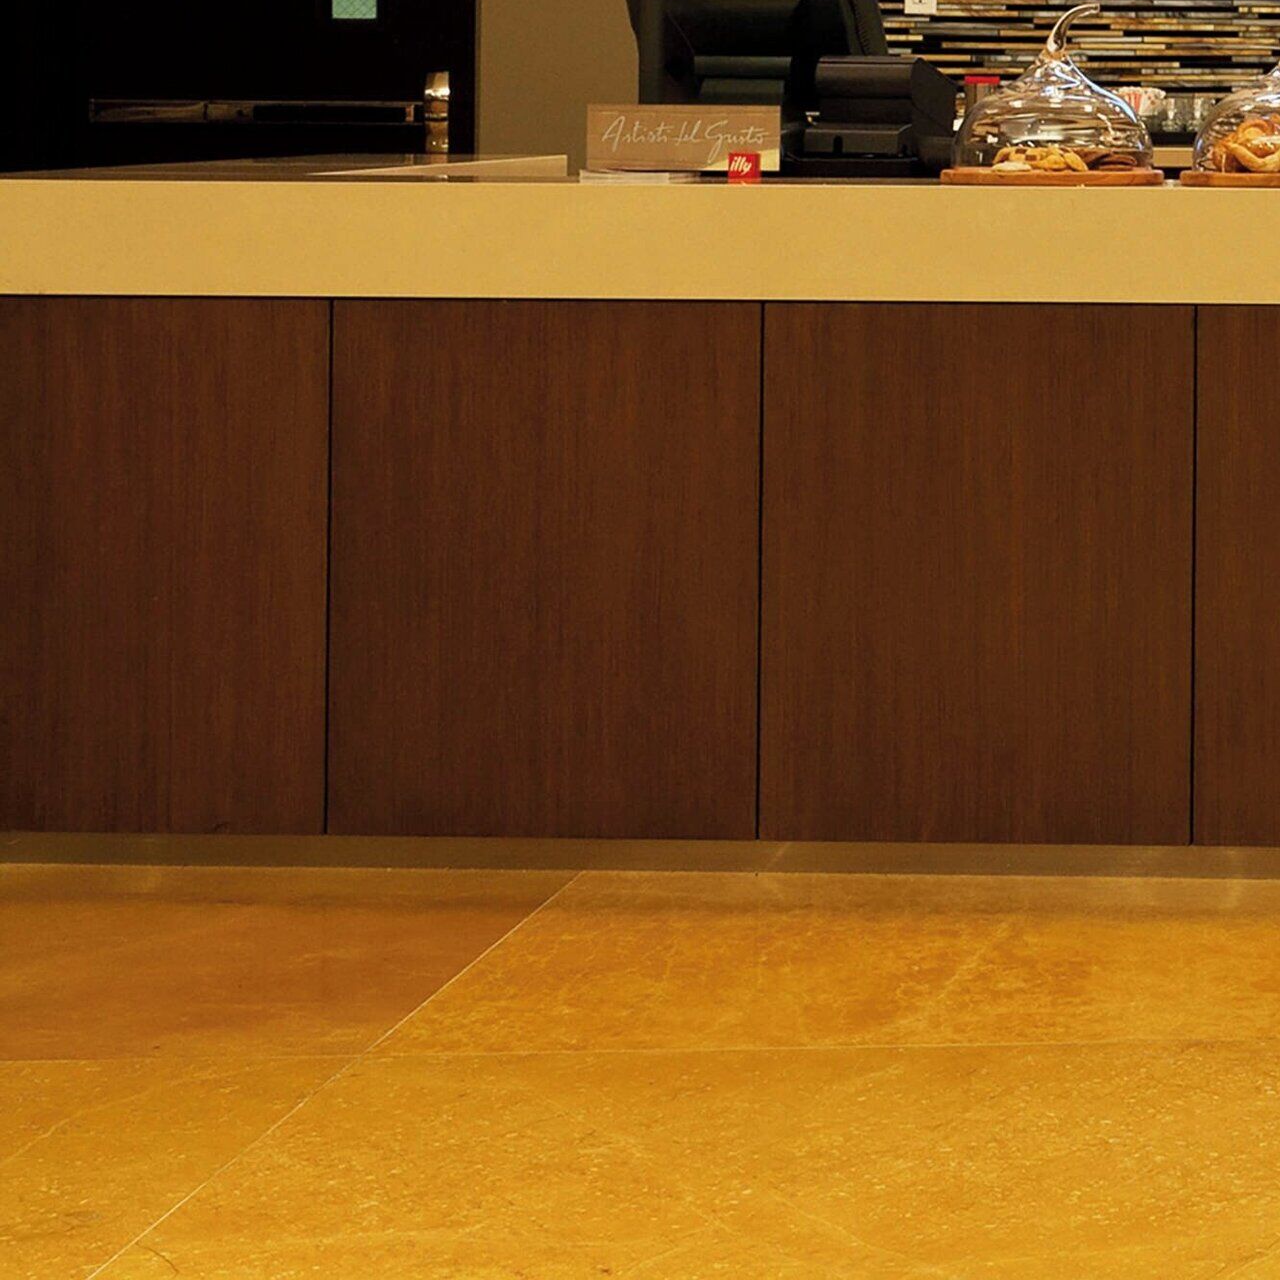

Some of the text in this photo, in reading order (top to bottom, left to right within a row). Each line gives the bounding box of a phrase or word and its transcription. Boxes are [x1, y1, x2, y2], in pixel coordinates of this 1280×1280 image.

[602, 116, 671, 152] Artisti
[704, 120, 768, 163] Gusto
[730, 156, 752, 176] illy
